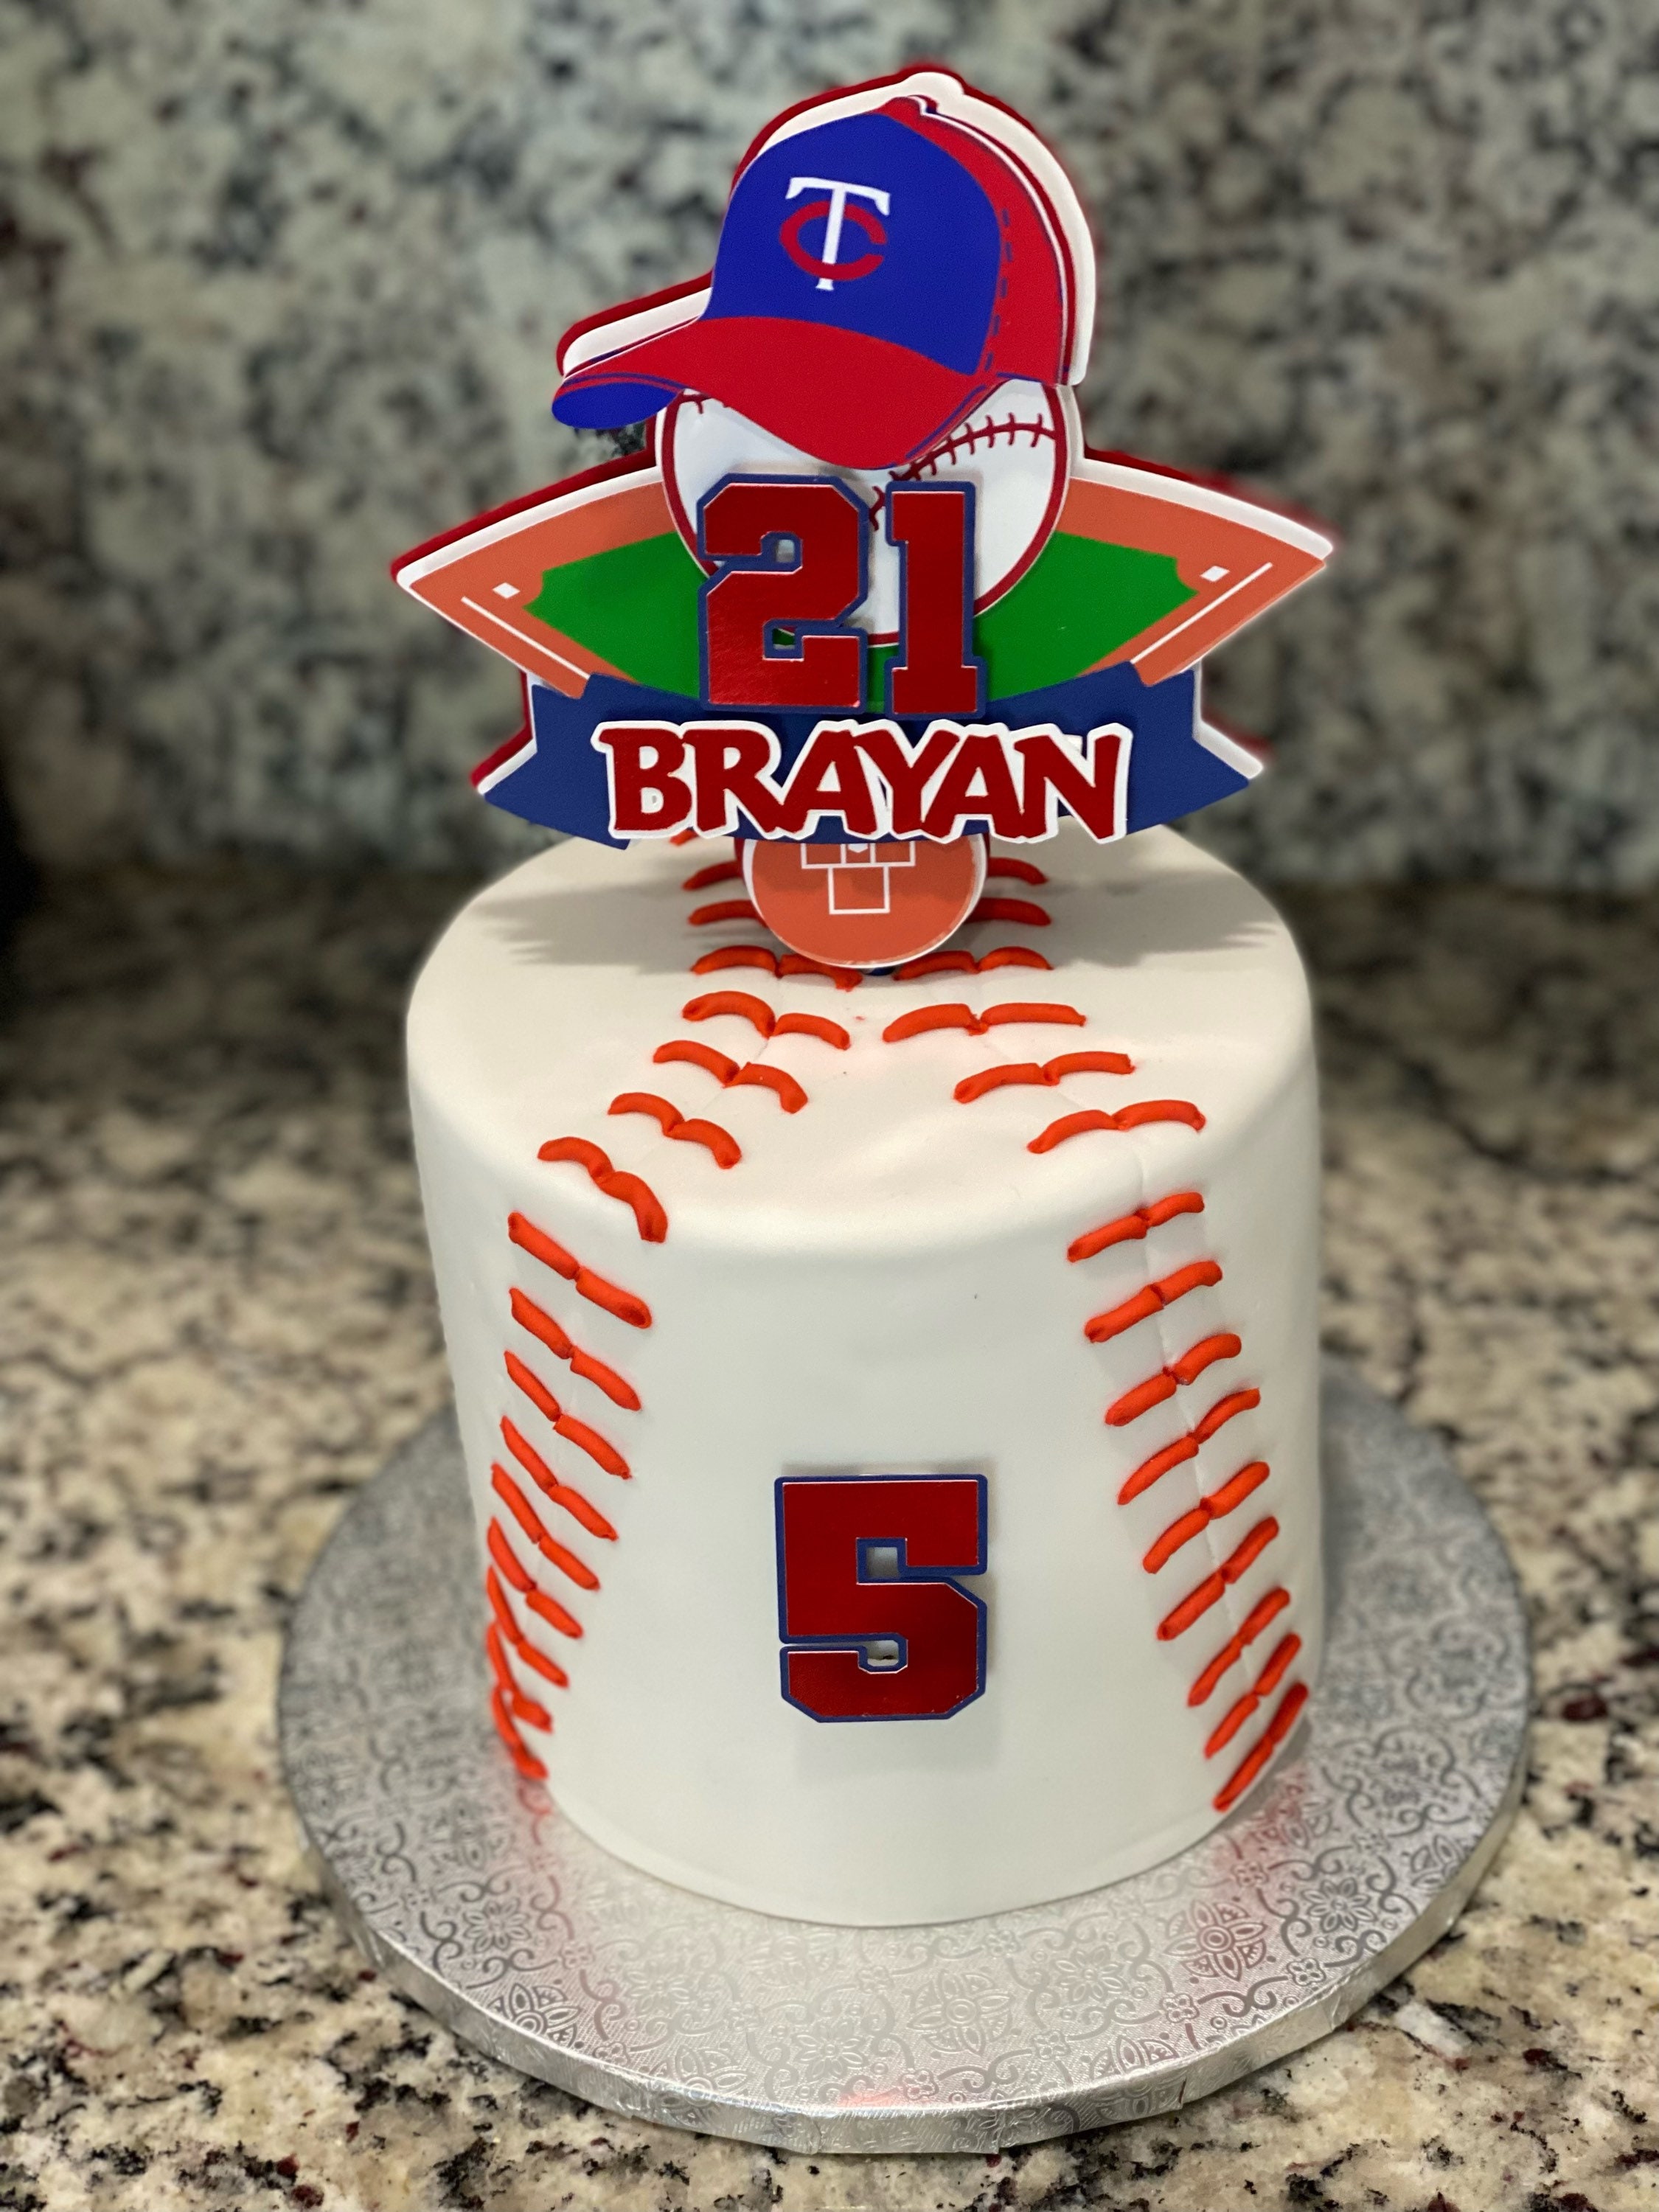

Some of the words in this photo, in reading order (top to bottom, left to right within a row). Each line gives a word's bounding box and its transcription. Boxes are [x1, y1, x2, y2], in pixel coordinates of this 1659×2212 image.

[699, 475, 985, 717] 21
[594, 721, 1133, 842] BRAYAN
[774, 1474, 988, 1723] 5
